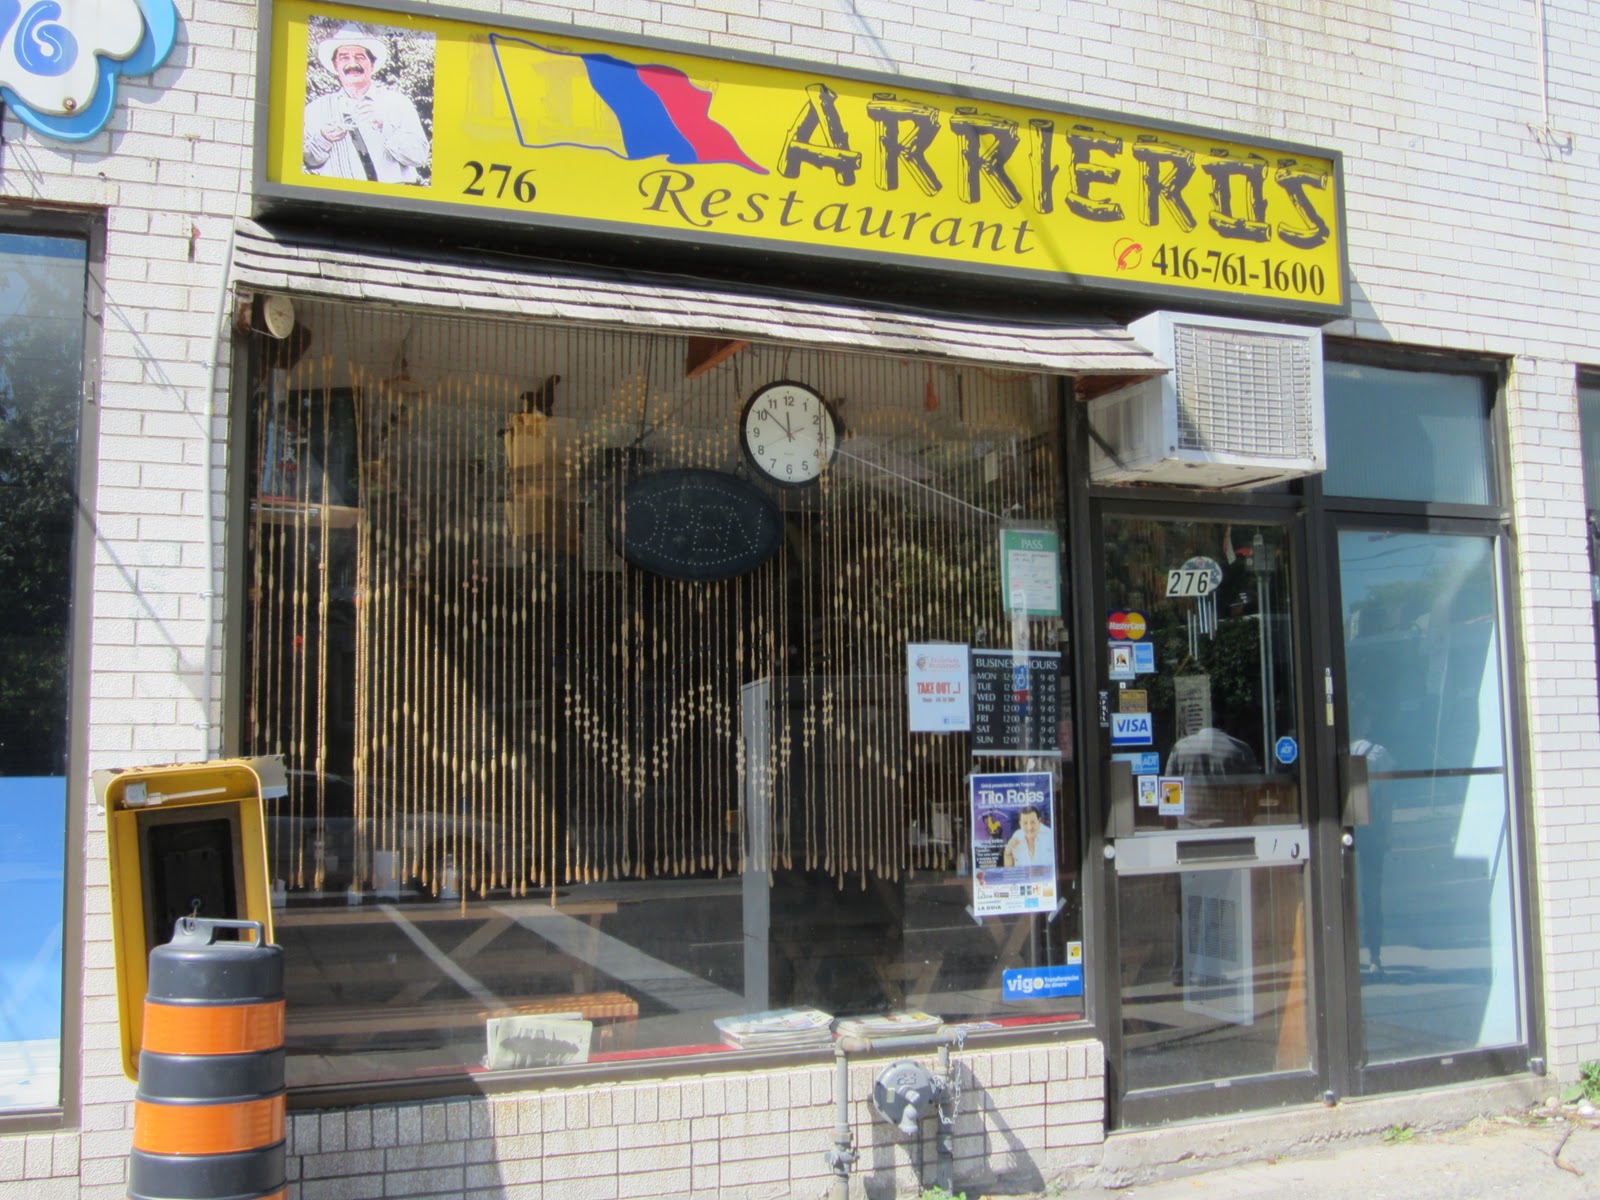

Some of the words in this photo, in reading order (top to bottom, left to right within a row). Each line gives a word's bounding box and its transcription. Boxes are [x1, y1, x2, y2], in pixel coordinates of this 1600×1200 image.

[776, 83, 1331, 249] ARRIEROS
[462, 160, 537, 203] 276
[638, 169, 1035, 254] Restaurant
[1152, 243, 1325, 296] 416-761-1600
[768, 399, 777, 409] 11
[783, 395, 795, 407] 12
[803, 402, 808, 412] 1
[757, 410, 767, 421] 10
[813, 415, 820, 425] 2
[753, 427, 760, 438] 9
[758, 445, 764, 455] 8
[770, 458, 776, 469] 7
[786, 464, 792, 474] 6
[802, 461, 808, 471] 5
[1021, 539, 1043, 549] PASS
[1169, 571, 1209, 594] 276
[1108, 622, 1146, 630] MasterCard
[976, 658, 1019, 668] BUSINES
[1025, 660, 1058, 670] HOURS
[977, 672, 997, 680] MON
[917, 682, 934, 694] TAKE
[936, 682, 951, 694] OUT
[976, 725, 991, 733] SAT
[1117, 719, 1148, 732] VISA
[976, 736, 994, 744] SUN
[978, 790, 1004, 805] Tito
[1006, 789, 1044, 806] Rojas
[1007, 975, 1044, 994] vigo
